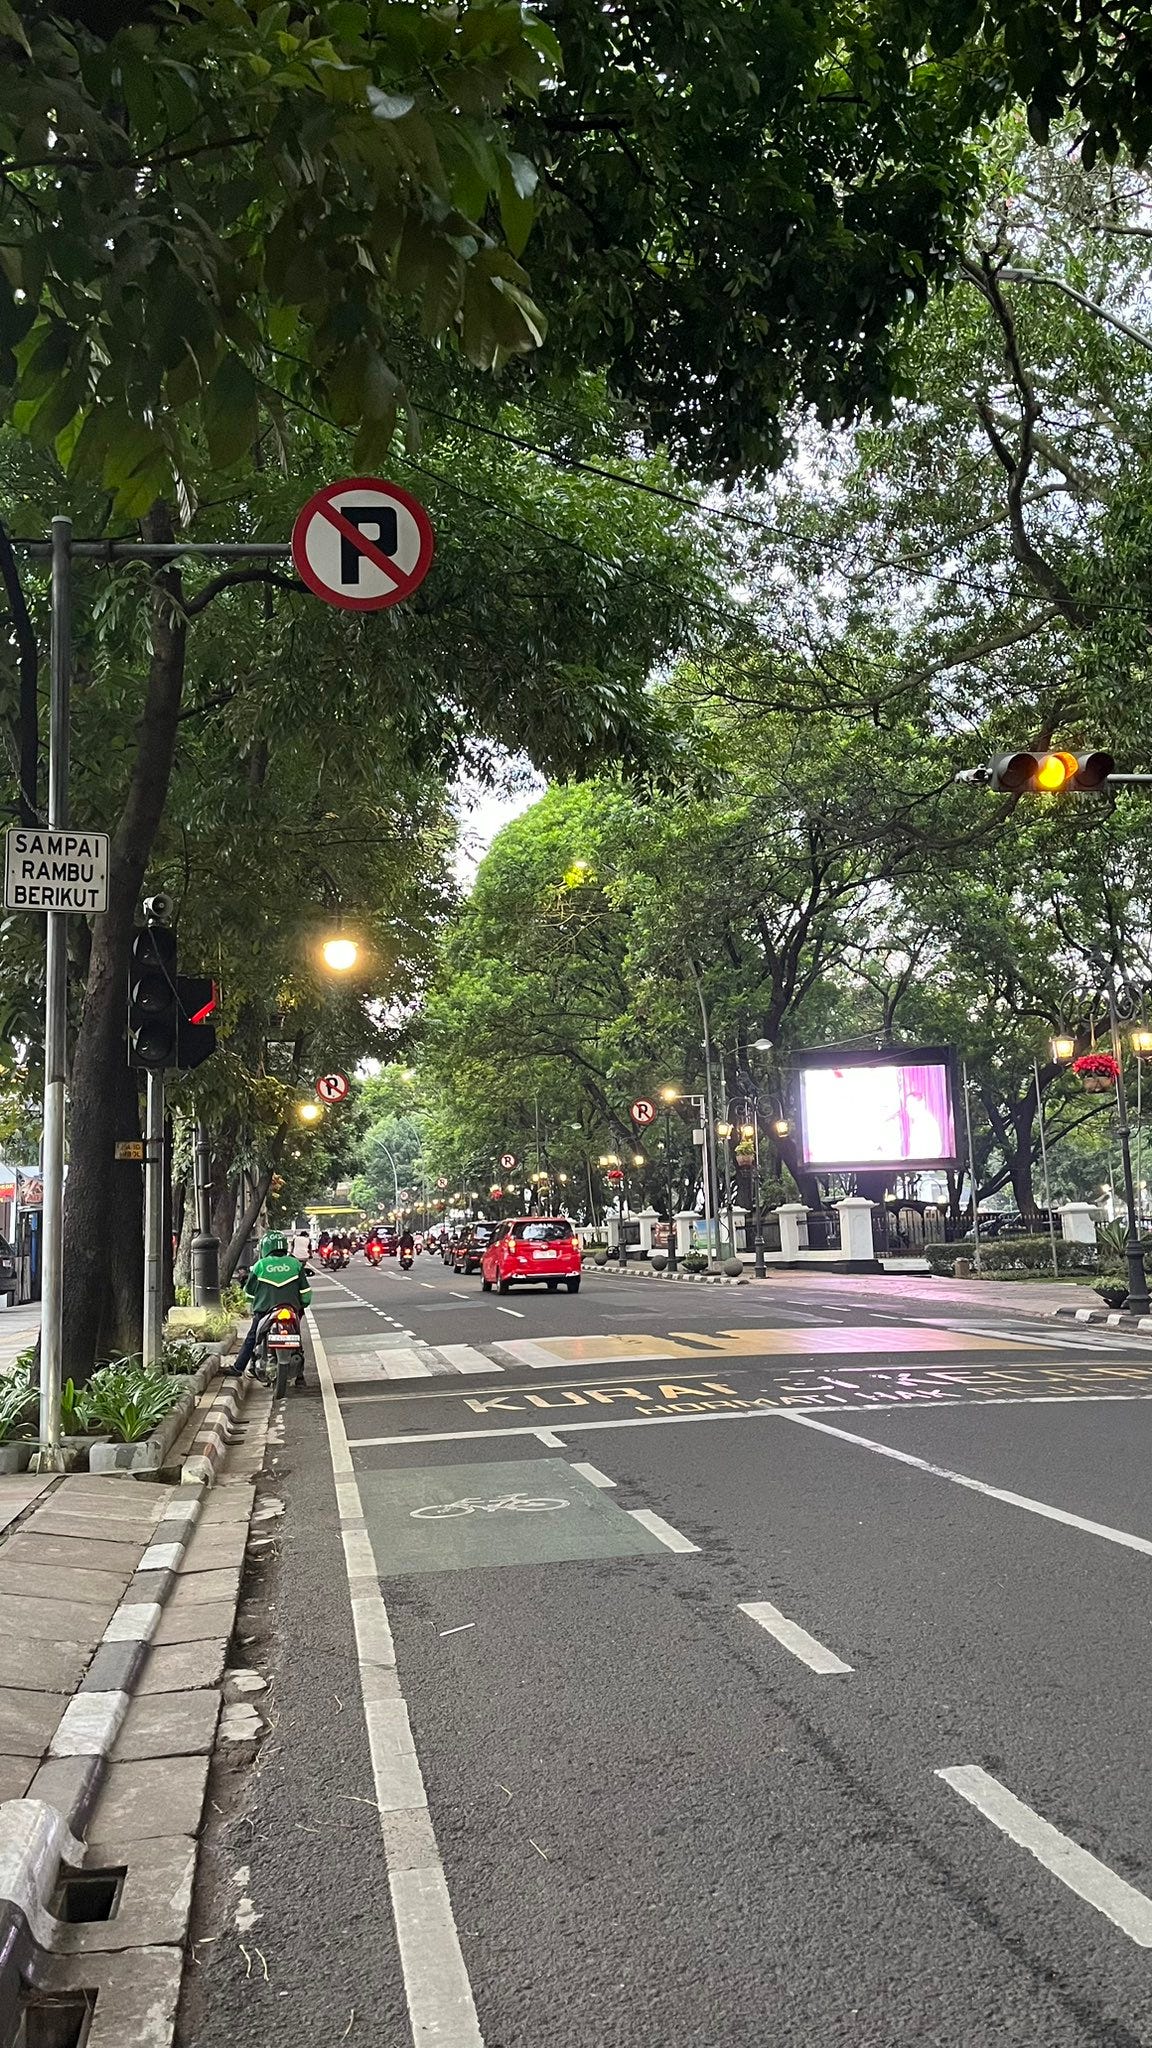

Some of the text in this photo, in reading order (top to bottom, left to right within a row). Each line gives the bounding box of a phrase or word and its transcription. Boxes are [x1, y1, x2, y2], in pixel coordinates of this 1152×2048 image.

[341, 507, 398, 584] P
[15, 834, 99, 858] SAMPAI
[22, 860, 94, 882] RAMBU
[14, 885, 99, 907] BERIKUT
[265, 1263, 290, 1273] Grab
[635, 1394, 848, 1415] HORMATI
[854, 1389, 962, 1401] HAK
